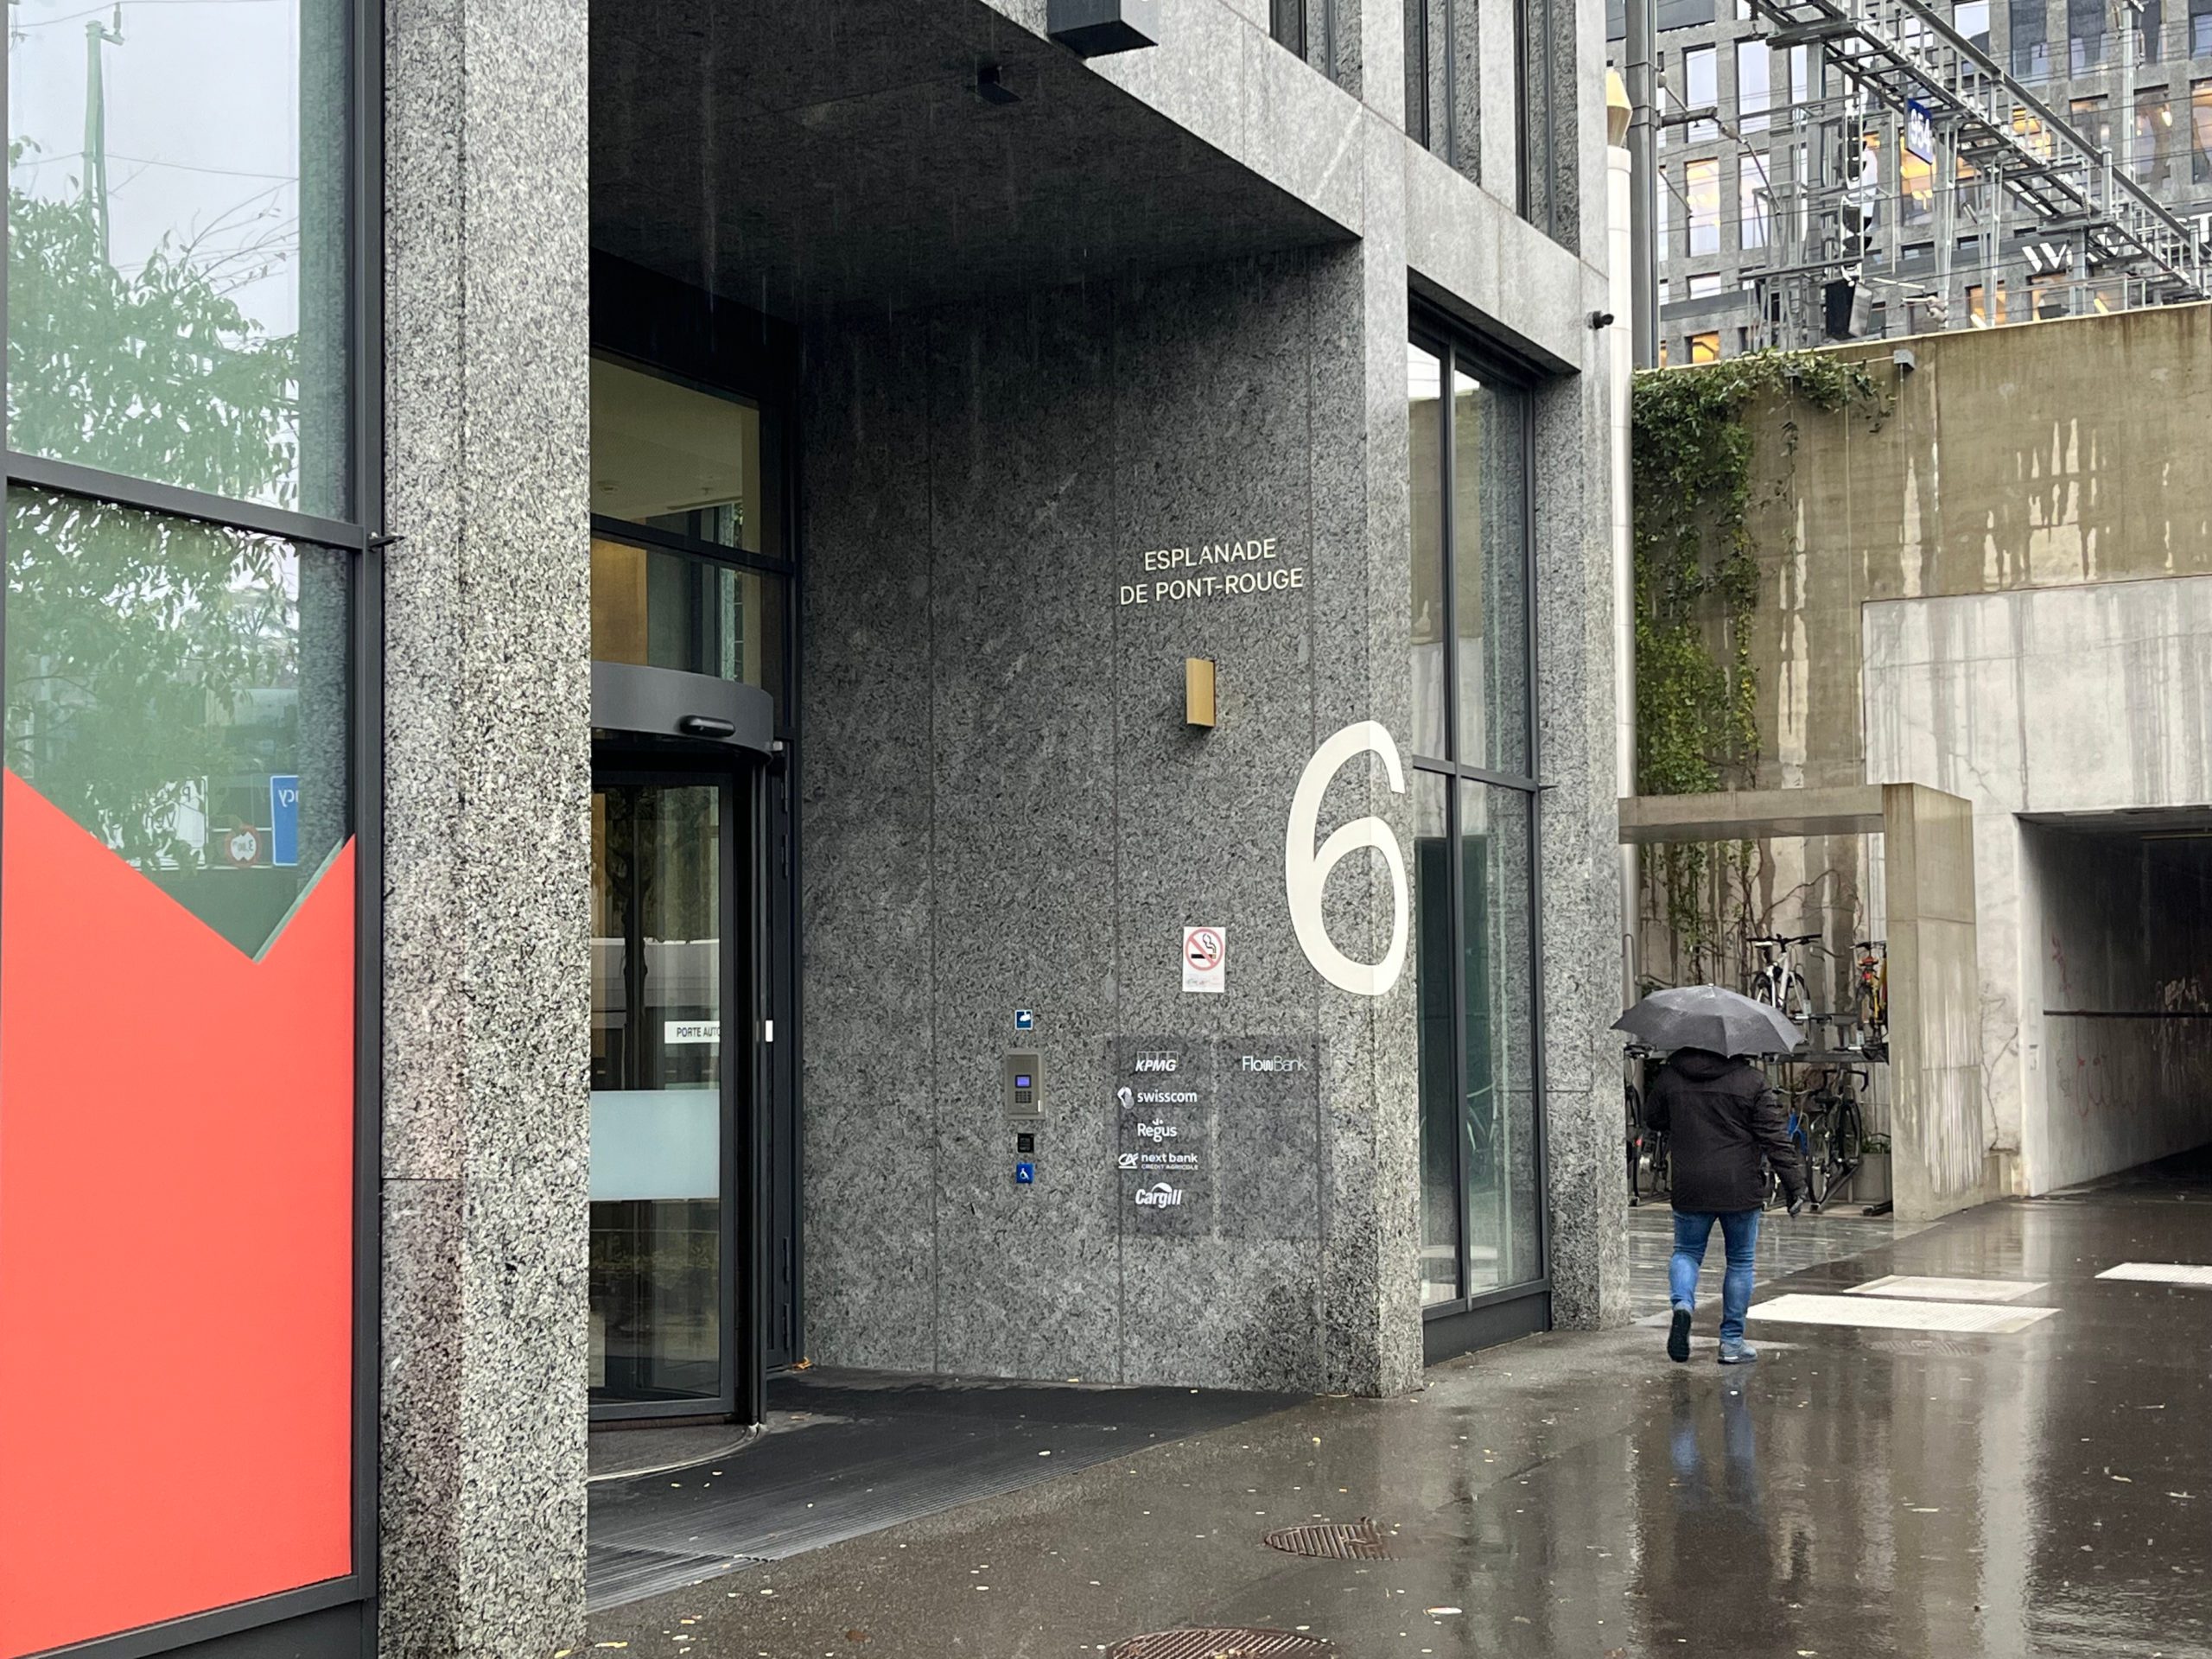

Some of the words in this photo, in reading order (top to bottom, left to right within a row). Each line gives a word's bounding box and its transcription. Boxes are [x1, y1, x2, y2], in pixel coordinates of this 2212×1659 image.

[1910, 108, 1932, 154] 954
[1144, 538, 1276, 571] ESPLANADE
[1120, 584, 1148, 605] DE
[1155, 568, 1304, 601] PONT-ROUGE
[1286, 720, 1409, 996] 6
[677, 1027, 701, 1037] PORTE
[1135, 1058, 1176, 1072] KPMG
[1242, 1056, 1307, 1071] FlowBank
[1137, 1089, 1198, 1103] swisscom
[1137, 1118, 1178, 1142] Regus
[1141, 1154, 1167, 1163] next
[1168, 1153, 1198, 1163] bank
[1135, 1188, 1183, 1209] Cargill
